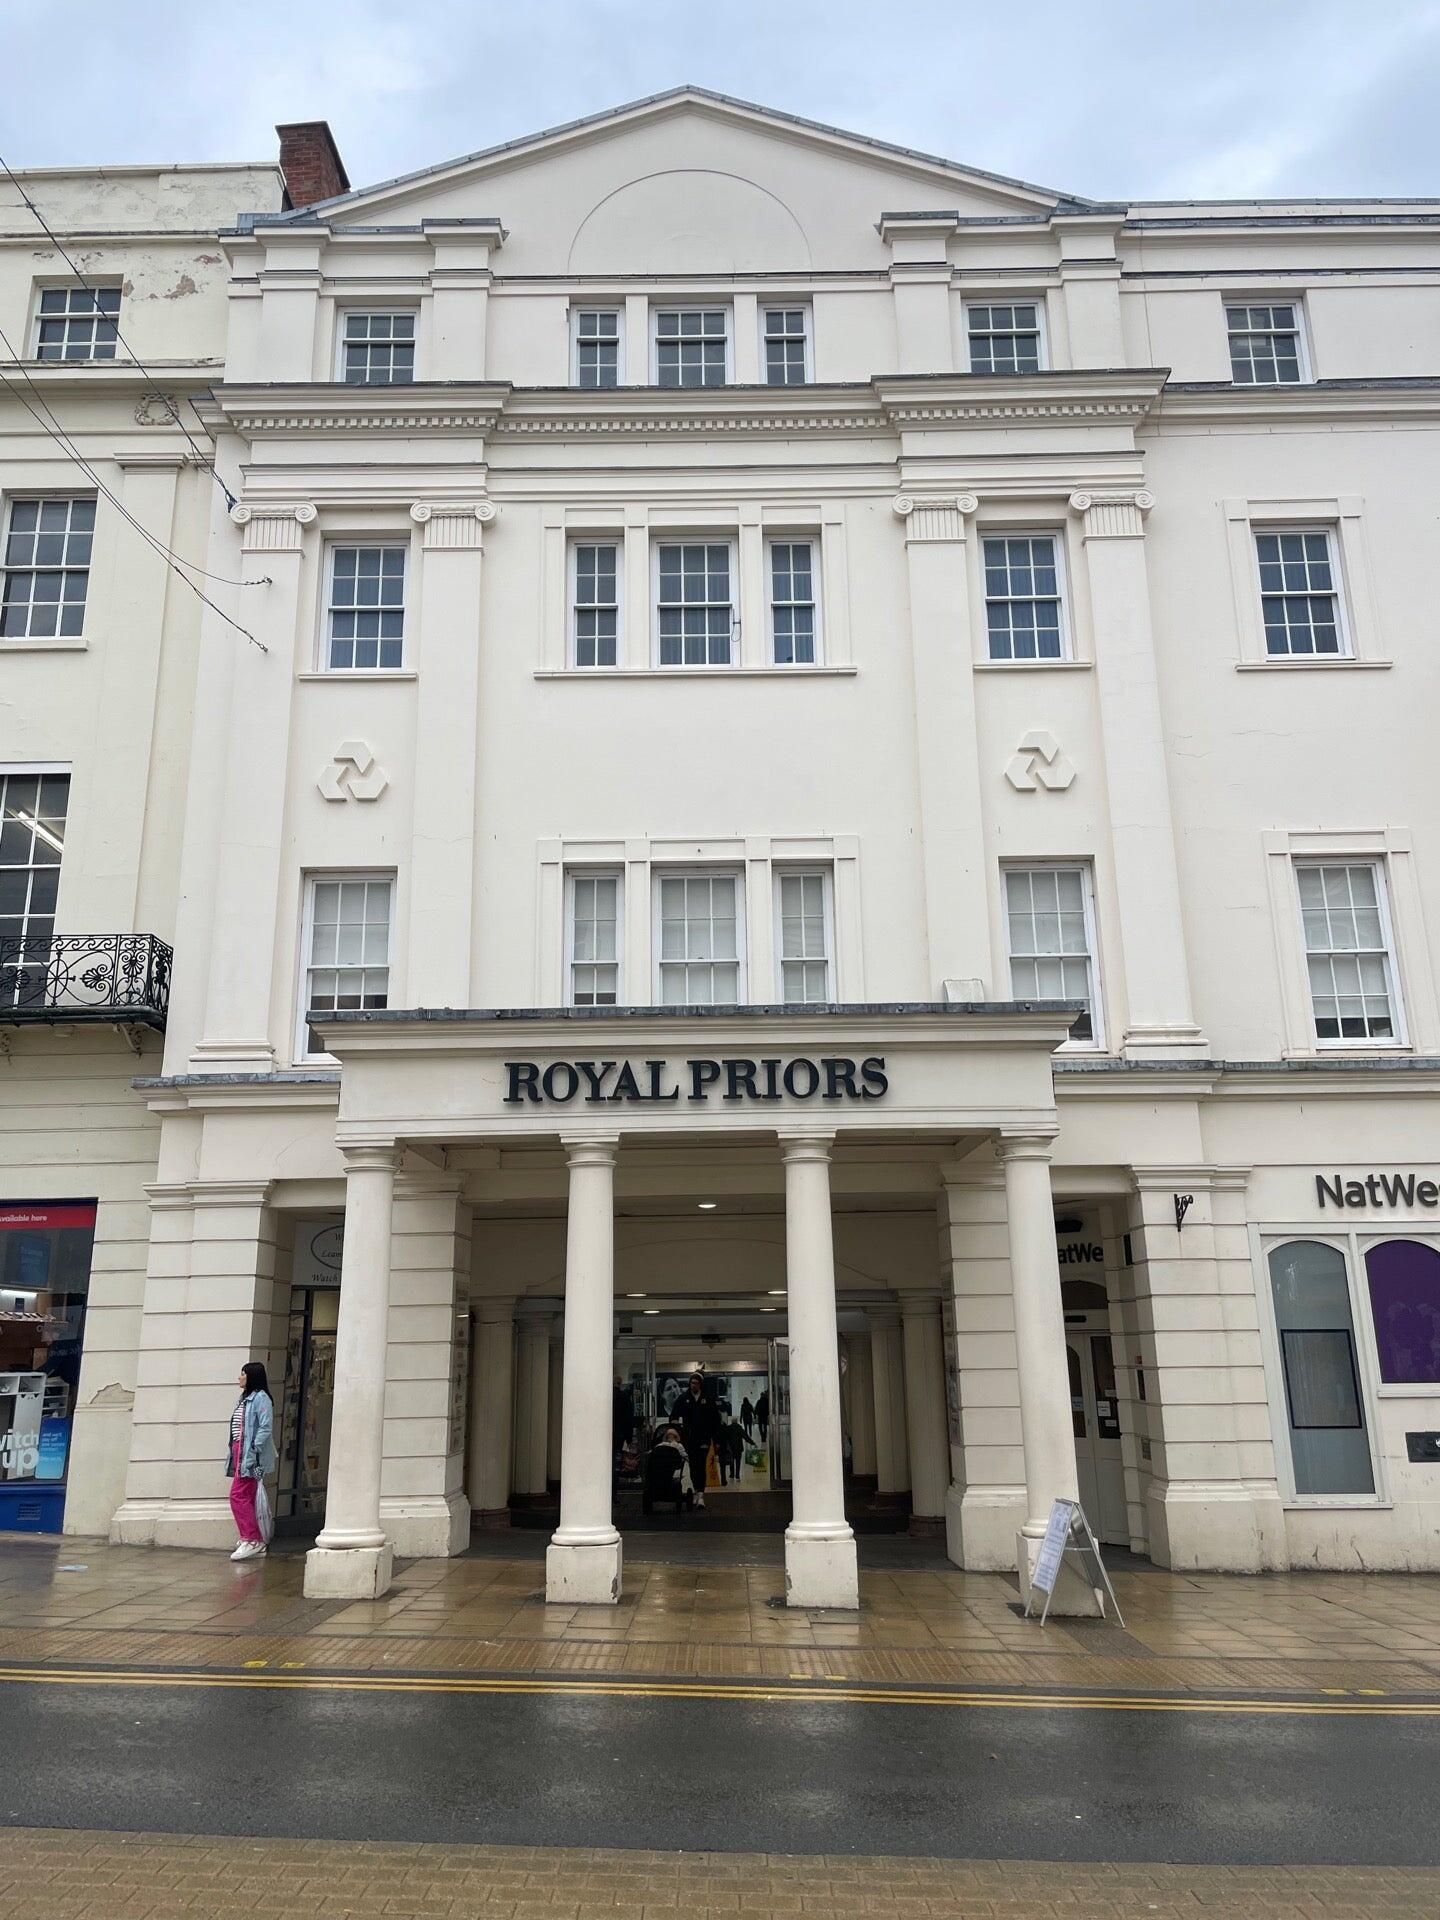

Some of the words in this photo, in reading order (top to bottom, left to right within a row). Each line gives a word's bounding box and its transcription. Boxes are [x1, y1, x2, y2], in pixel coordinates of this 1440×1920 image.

[503, 1060, 679, 1102] ROYAL
[687, 1057, 889, 1100] PRIORS
[1315, 1173, 1440, 1208] NatWe
[0, 1214, 30, 1222] vailable
[30, 1214, 48, 1222] here
[3, 1447, 40, 1477] up
